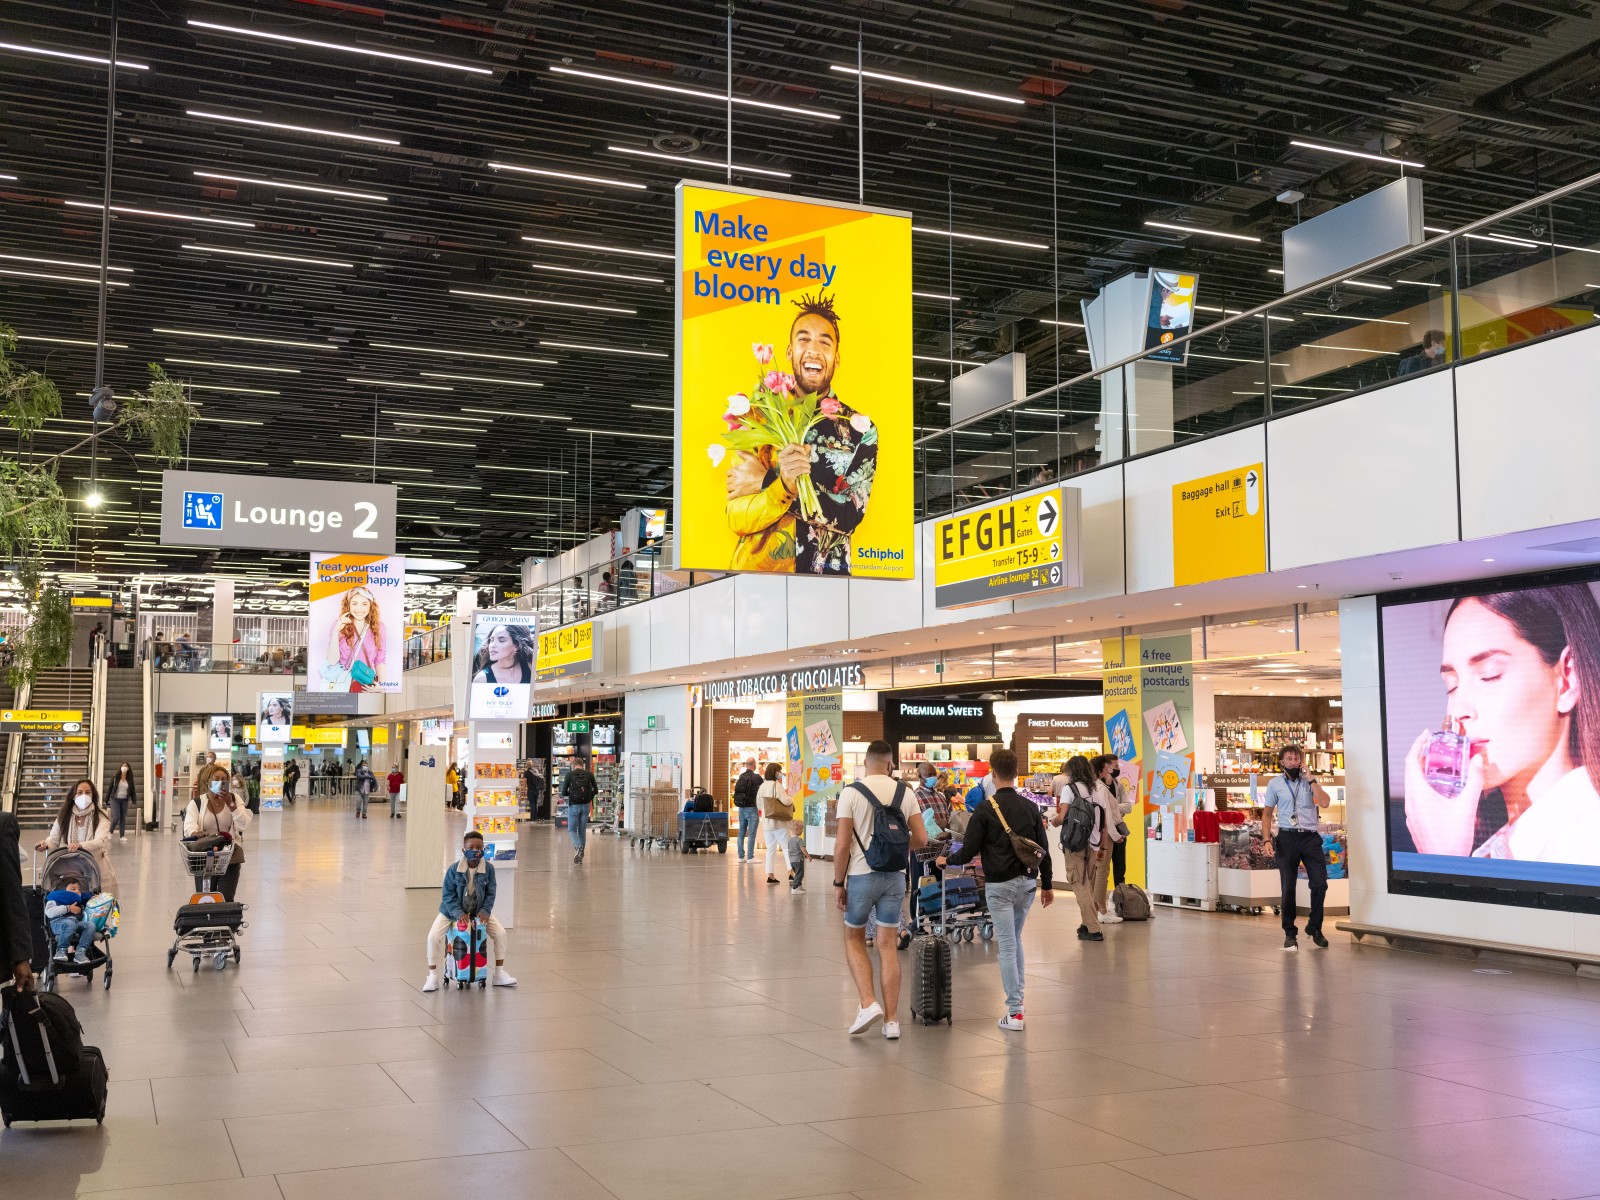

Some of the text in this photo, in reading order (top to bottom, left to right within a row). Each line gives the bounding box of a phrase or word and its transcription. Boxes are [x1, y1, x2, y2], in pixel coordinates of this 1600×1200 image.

[694, 210, 768, 242] Make
[707, 249, 837, 287] every day
[694, 271, 780, 305] bloom
[1182, 480, 1230, 501] Baggage hall
[1216, 506, 1231, 518] Exit
[234, 500, 379, 539] Lounge 2
[1016, 527, 1033, 538] Gates
[858, 547, 904, 561] Schiphol
[993, 547, 1038, 567] Transfer T5-9
[315, 562, 389, 573] Treat yourself
[883, 564, 904, 572] Airport
[320, 574, 400, 587] to some happy
[988, 576, 1008, 587] Airline
[1009, 573, 1030, 583] lounge
[573, 628, 579, 649] D
[1143, 649, 1172, 660] 4 free
[1148, 664, 1183, 675] unique
[704, 664, 861, 700] LIQUOR TOBACCO & CHOCOLATES
[1108, 673, 1133, 685] unique
[1143, 676, 1190, 688] postcards
[1104, 685, 1138, 698] postcards
[805, 702, 841, 711] postcards
